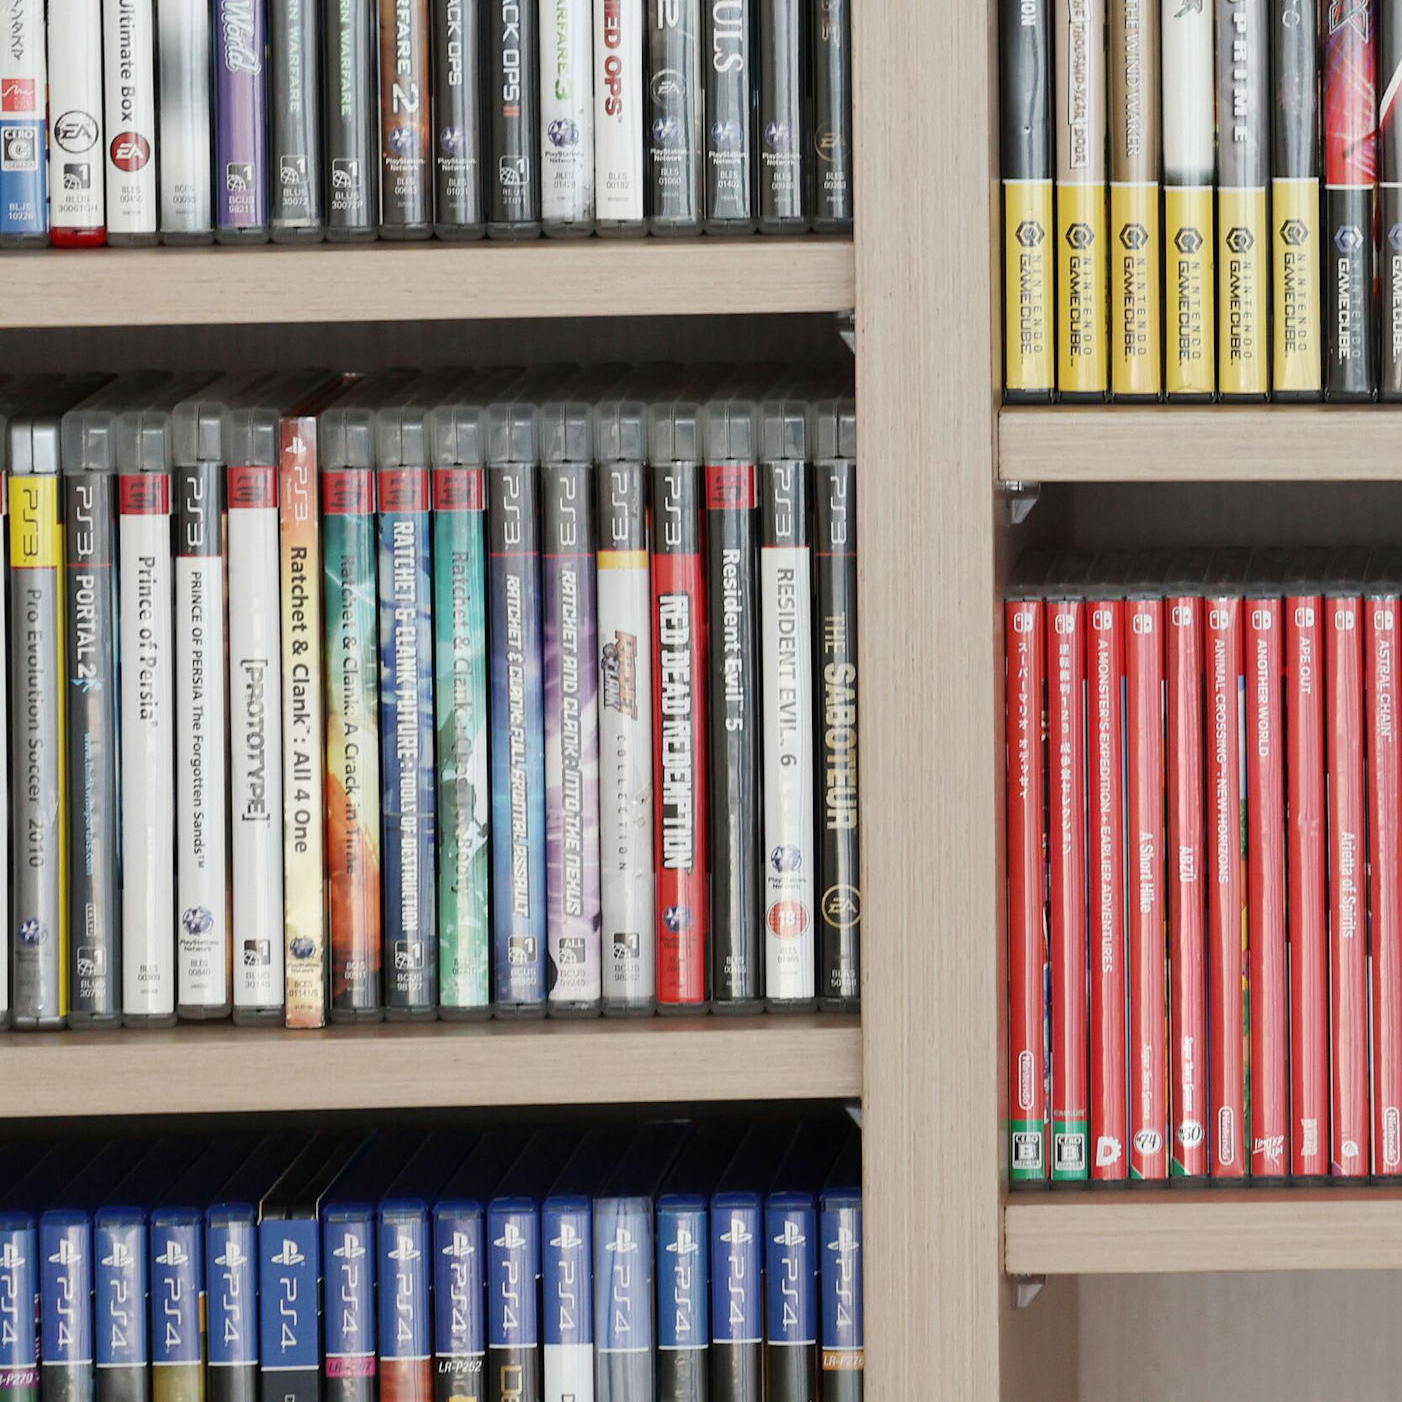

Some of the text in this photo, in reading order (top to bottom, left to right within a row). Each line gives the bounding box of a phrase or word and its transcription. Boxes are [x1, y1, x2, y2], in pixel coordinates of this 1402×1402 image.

[120, 86, 138, 122] Box
[604, 56, 624, 116] OPS
[1233, 12, 1247, 143] PRIME
[1123, 256, 1134, 358] GAMECUBE
[1135, 260, 1146, 355] NINTENDO
[190, 571, 205, 623] PRINCE
[289, 547, 309, 632] Ratchet
[76, 575, 97, 679] PORTAL 2
[191, 628, 205, 647] OF
[291, 639, 309, 656] &
[191, 651, 205, 699] PERSIA
[1257, 639, 1269, 756] ANOTHER WORLD
[1299, 637, 1311, 694] APE OUT
[192, 705, 206, 730] The
[659, 596, 693, 868] RED DEAD REDEMPTION
[824, 612, 857, 830] THE SABOTEUR
[189, 735, 206, 808] Forgotten
[293, 751, 311, 778] All
[294, 788, 310, 802] 4
[293, 810, 311, 853] One
[1138, 832, 1155, 913] A Short Hike
[1339, 832, 1357, 937] Arietta of Spirits
[164, 1277, 182, 1348] PS4
[279, 1277, 297, 1348] PS4
[728, 1256, 746, 1324] PS4
